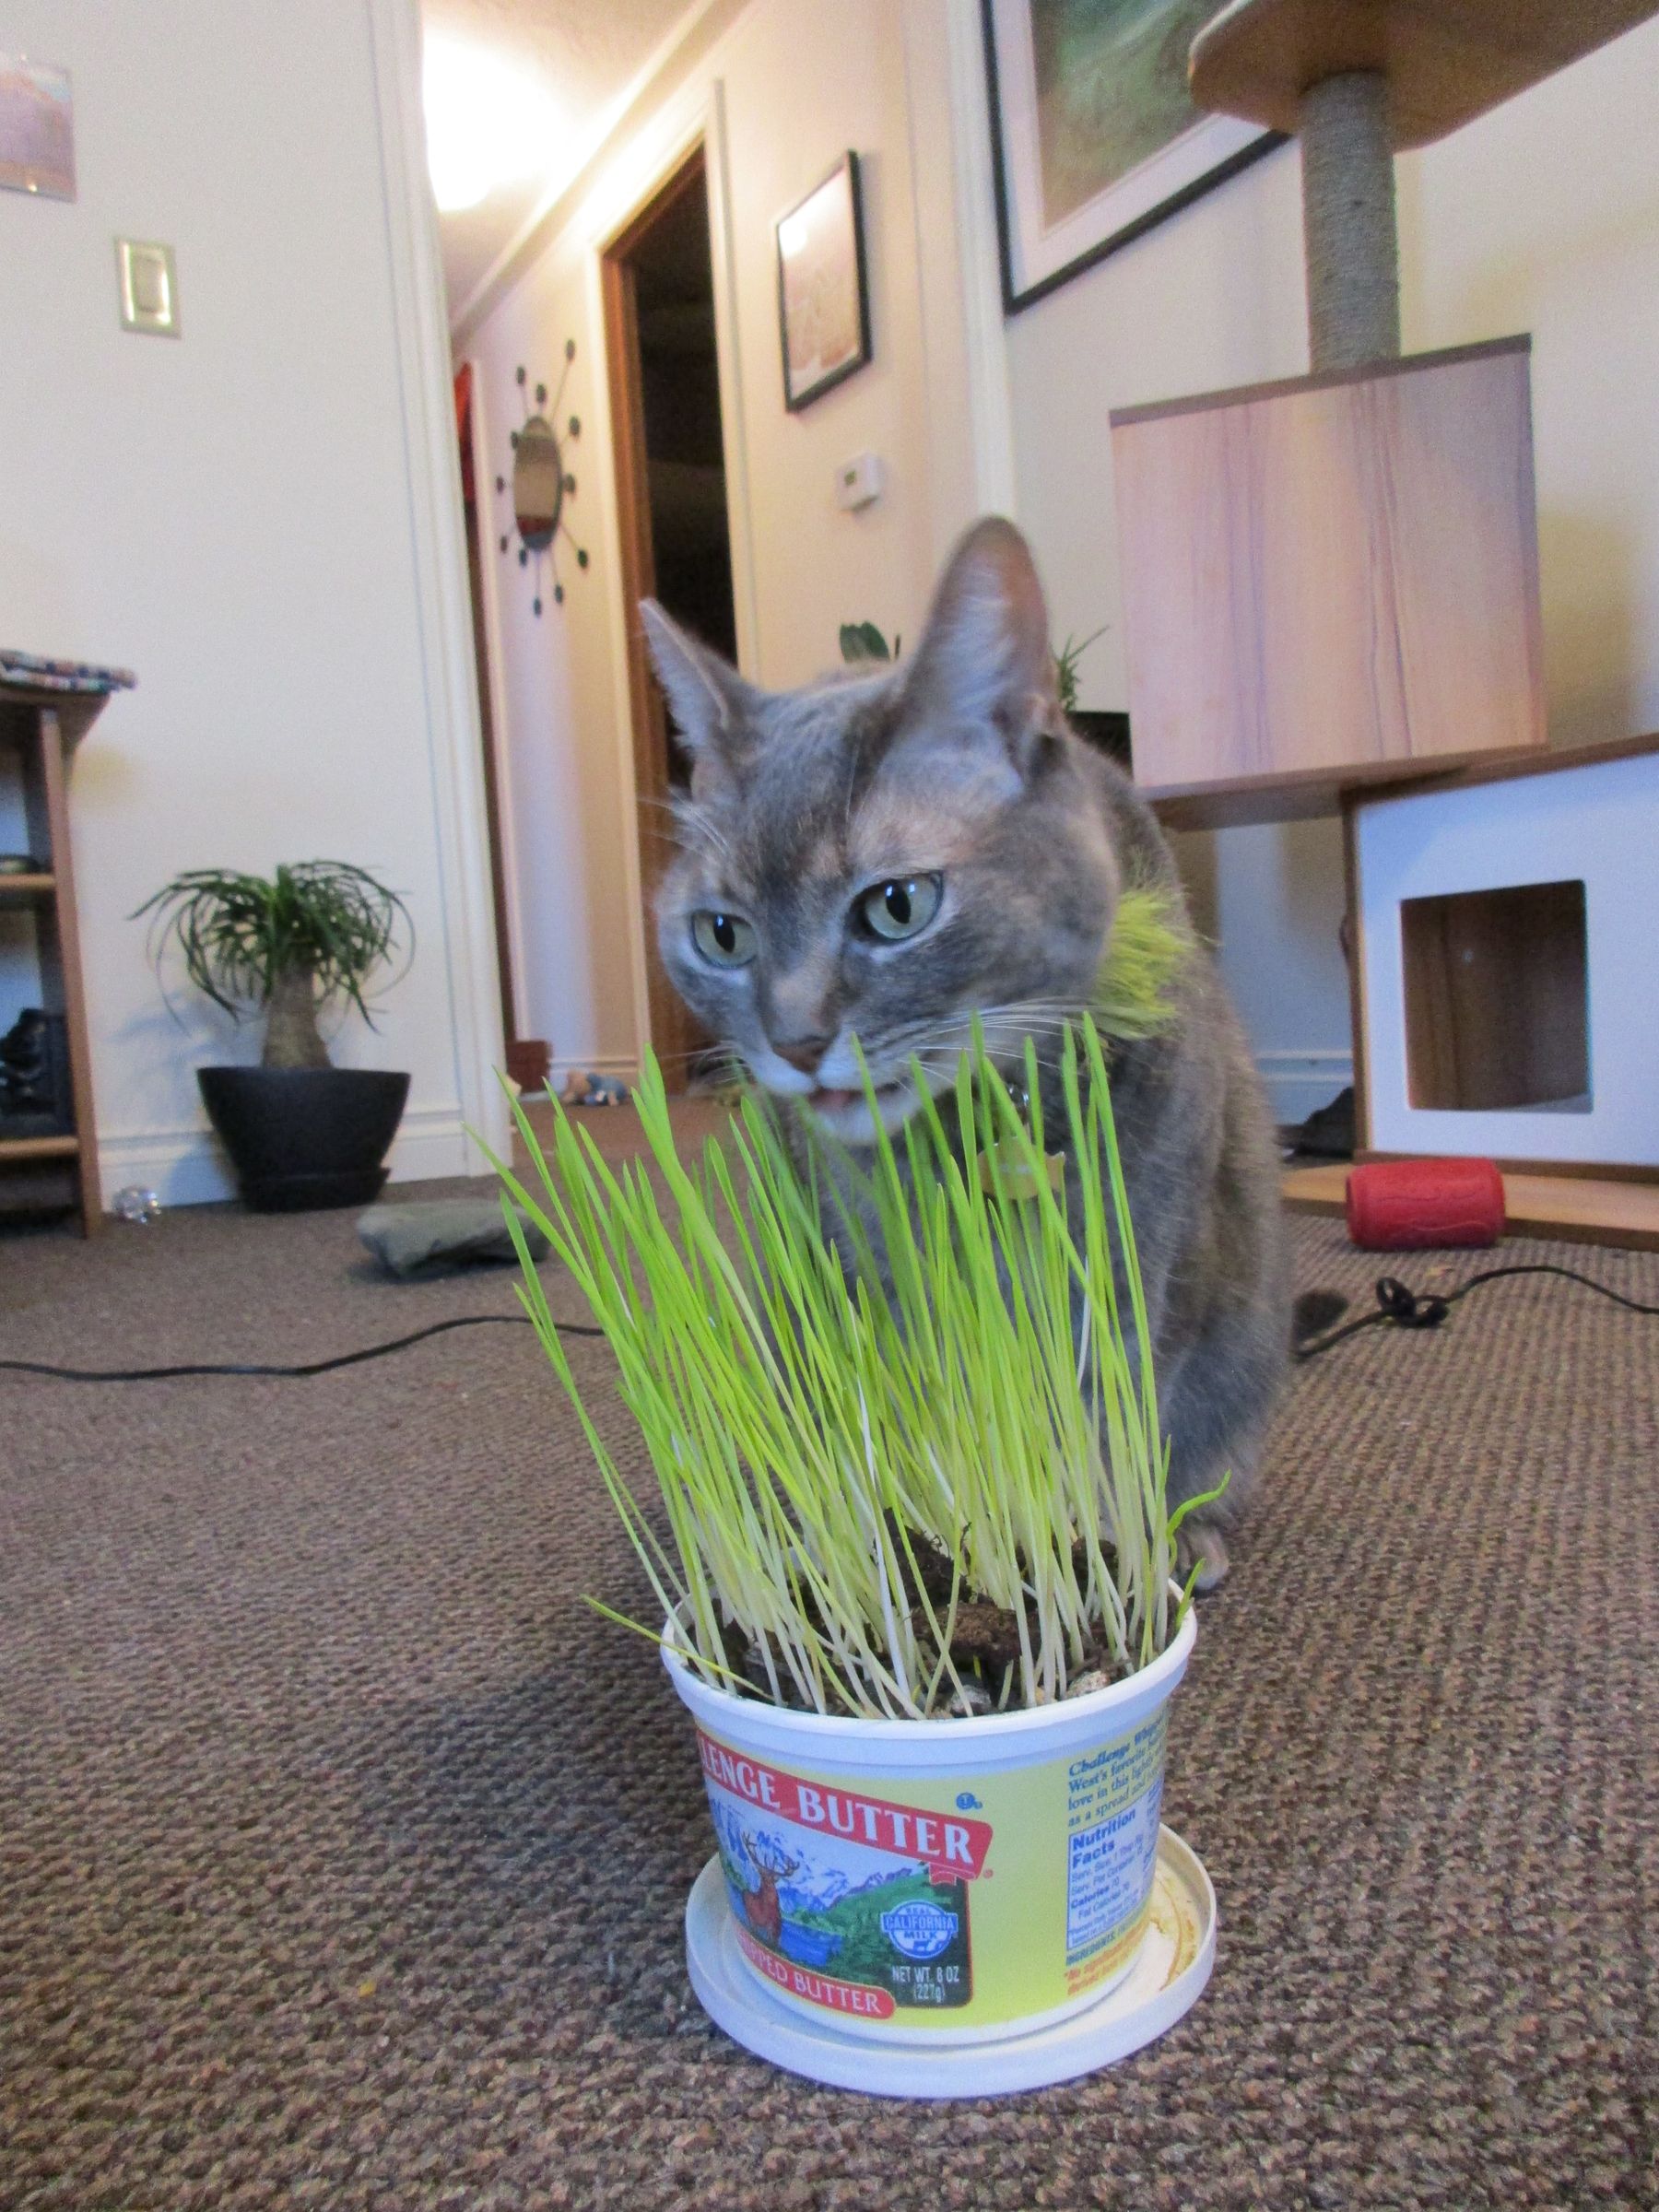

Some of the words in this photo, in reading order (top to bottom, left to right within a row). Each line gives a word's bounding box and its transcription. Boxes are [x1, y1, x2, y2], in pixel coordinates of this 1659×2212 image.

[1069, 1743, 1130, 1776] Challenge
[1068, 1794, 1093, 1810] love
[796, 1784, 974, 1865] BUTTER
[1068, 1815, 1081, 1827] as
[1085, 1810, 1091, 1821] a
[1073, 1808, 1135, 1851] Nutrition
[1073, 1840, 1115, 1869] Facts
[886, 1914, 955, 1930] CALIFORNIA
[903, 1931, 938, 1940] MILK
[890, 1965, 911, 1983] NET
[946, 1965, 959, 1983] OZ
[794, 1971, 882, 2015] BUTTER
